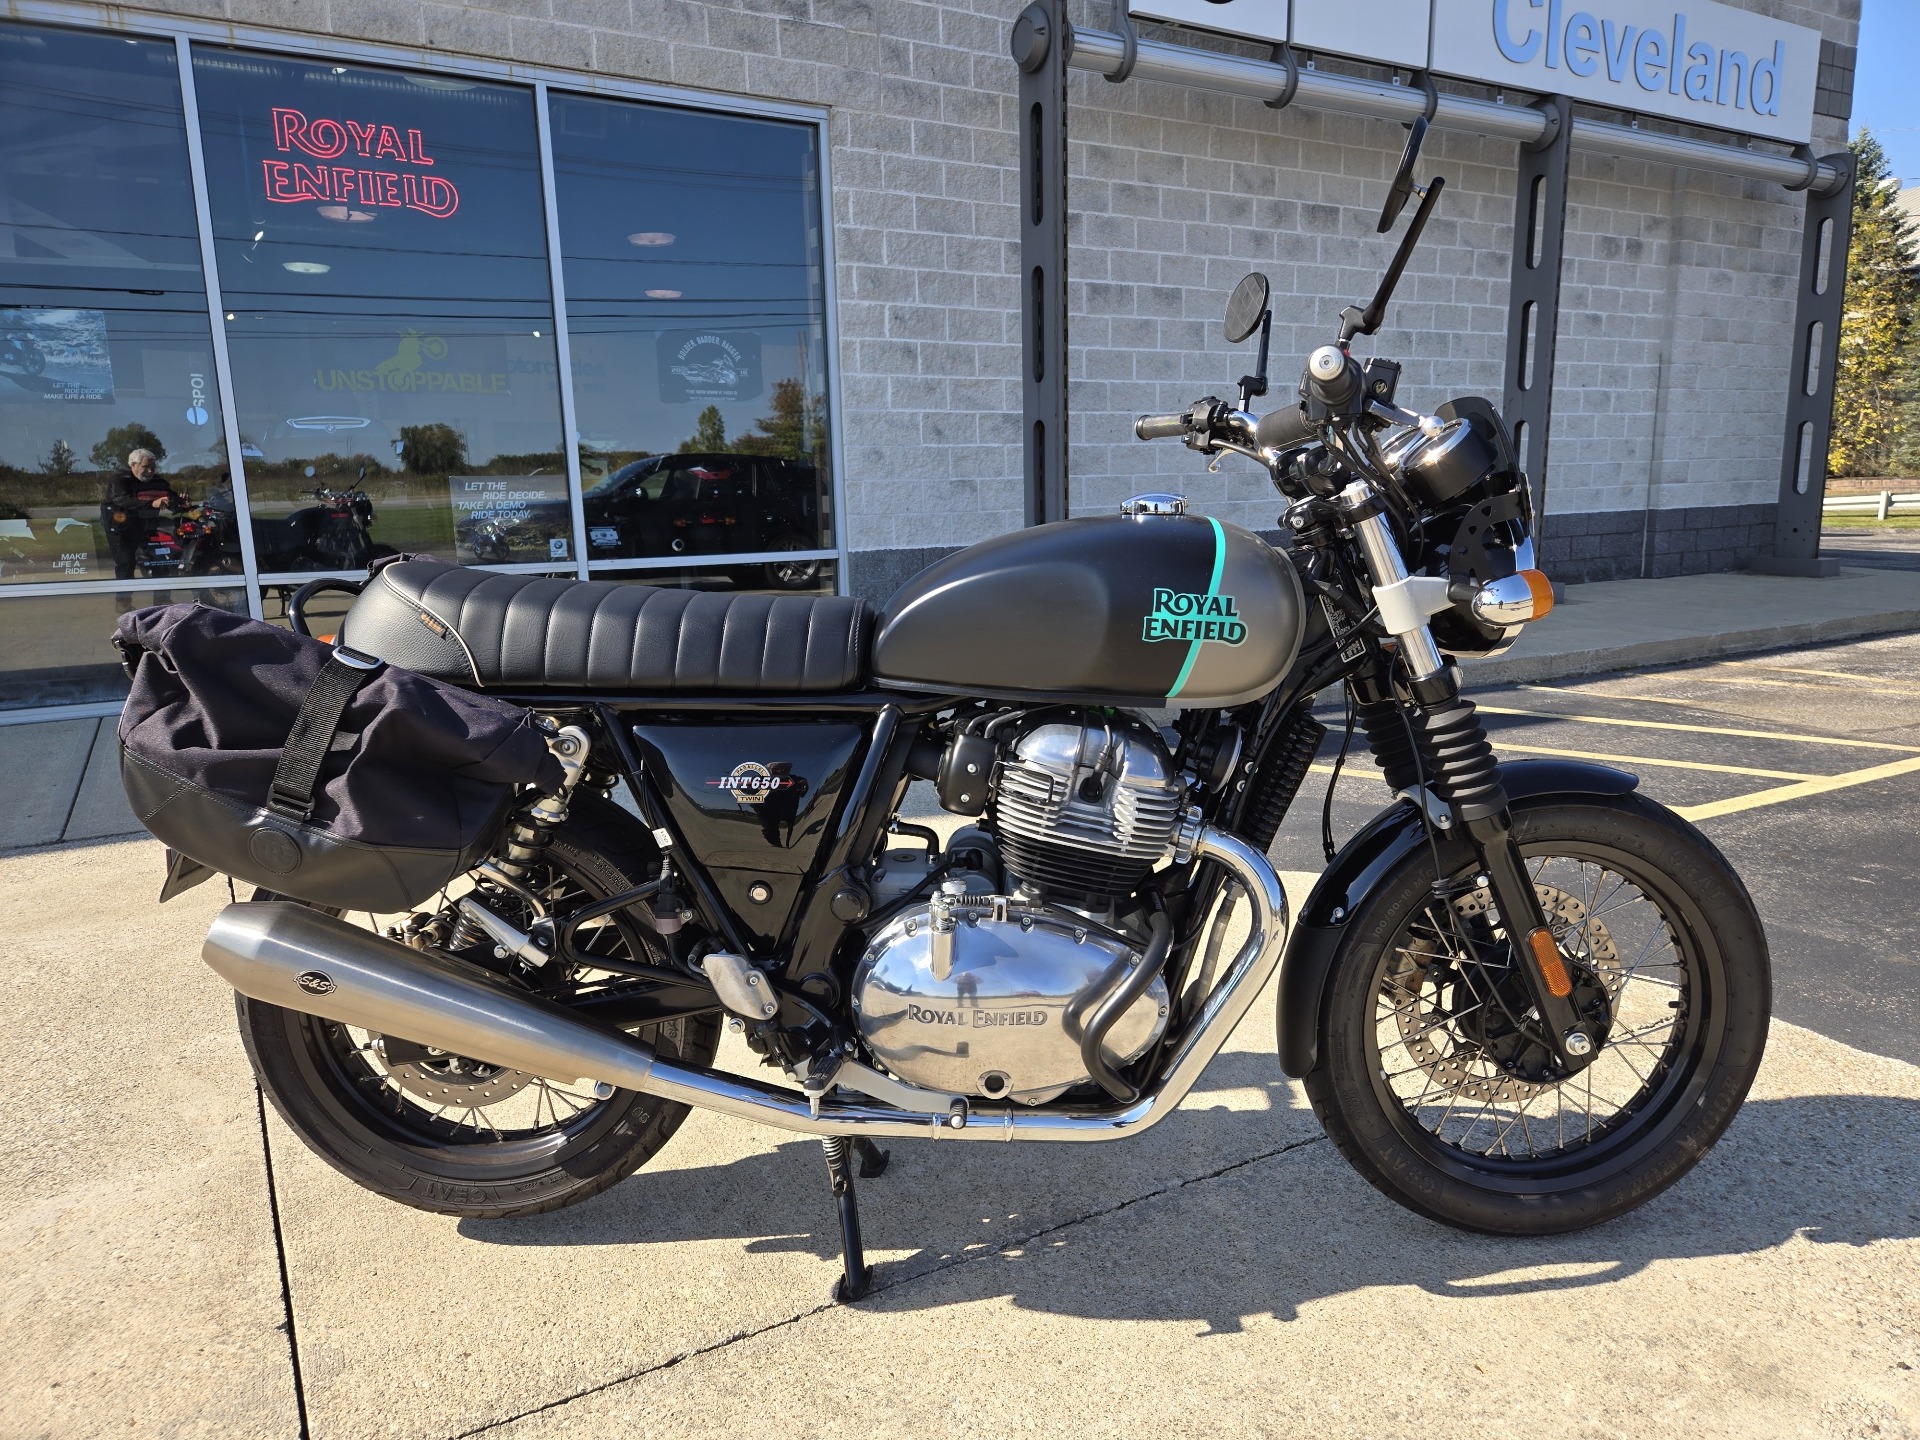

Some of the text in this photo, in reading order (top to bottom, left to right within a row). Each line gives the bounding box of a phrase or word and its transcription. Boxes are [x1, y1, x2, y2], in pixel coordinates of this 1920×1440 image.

[1492, 0, 1786, 117] Cleveland
[271, 107, 434, 166] ROYAL
[262, 160, 460, 219] ENFIELD
[316, 368, 506, 393] UNSTOPPABLE
[464, 481, 508, 491] LET THE
[482, 491, 547, 500] RIDE DECIDE.
[458, 501, 526, 510] TAKE A DEMO
[470, 510, 531, 519] RIDE TODAY.
[52, 560, 81, 568] LIFE A
[1153, 588, 1238, 617] ROYAL
[1143, 617, 1248, 645] ENFIELD
[718, 776, 781, 790] INT650
[1372, 868, 1435, 939] 100/90-18 M/C
[299, 975, 331, 991] S&S
[908, 1003, 1048, 1028] ROYAL ENFIELD
[421, 1181, 488, 1204] CEAT
